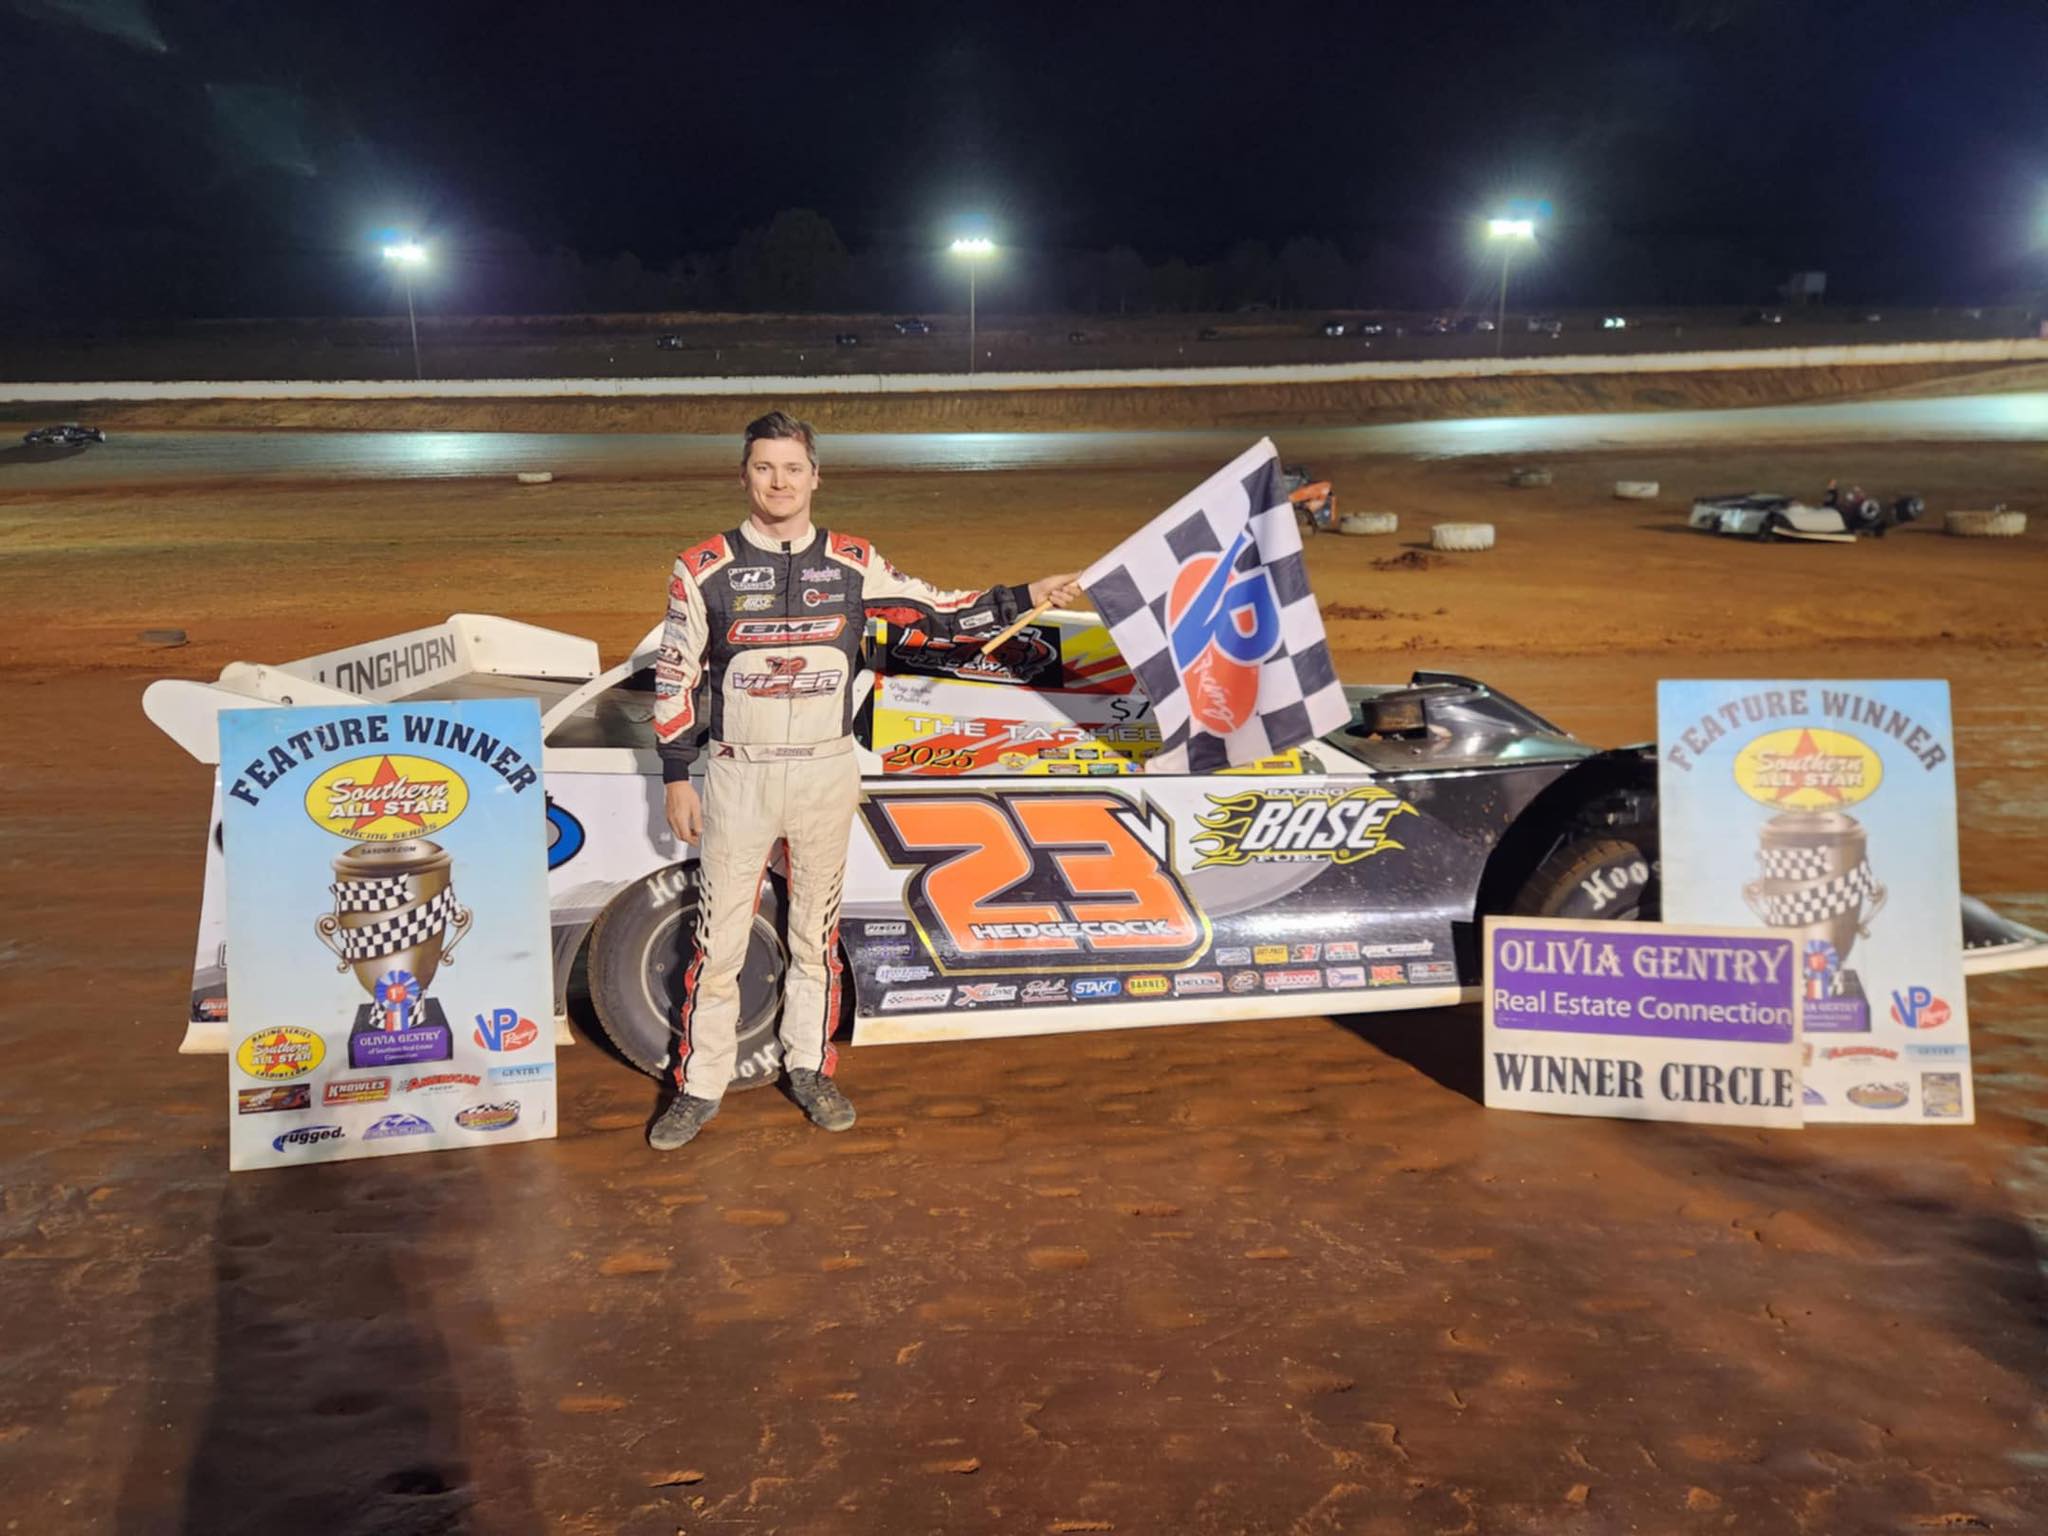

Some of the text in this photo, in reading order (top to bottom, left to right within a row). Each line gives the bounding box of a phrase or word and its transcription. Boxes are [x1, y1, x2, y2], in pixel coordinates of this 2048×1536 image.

[733, 669, 842, 689] VIPER
[906, 717, 987, 737] THE
[1667, 690, 1948, 771] FEATURE WINNER
[229, 715, 537, 806] FEATURE WINNER
[886, 744, 979, 769] 2025
[1754, 751, 1864, 775] Southern
[1754, 772, 1864, 787] ALL STAR
[328, 776, 449, 804] Southern
[1266, 788, 1347, 796] RACING
[328, 801, 449, 819] ALL STAR
[1239, 799, 1401, 850] BASE
[1256, 854, 1327, 863] FUEL
[969, 920, 1177, 940] HEDGECOCK
[1499, 937, 1625, 978] OLIVIA
[1632, 944, 1790, 984] GENTRY
[1131, 979, 1167, 989] BARNES
[1494, 989, 1547, 1013] Real
[1553, 992, 1632, 1018] Estate
[1638, 996, 1794, 1025] Connection
[1892, 986, 1932, 1029] VP
[360, 1030, 442, 1046] OLIVIA GENTRY
[475, 1008, 519, 1052] VP
[279, 1053, 312, 1063] STAR
[502, 1067, 541, 1077] GENTRY
[1493, 1052, 1794, 1107] WINNER CIRCLE
[328, 1080, 385, 1097] KNOWLES
[406, 1074, 481, 1093] AMERICAN
